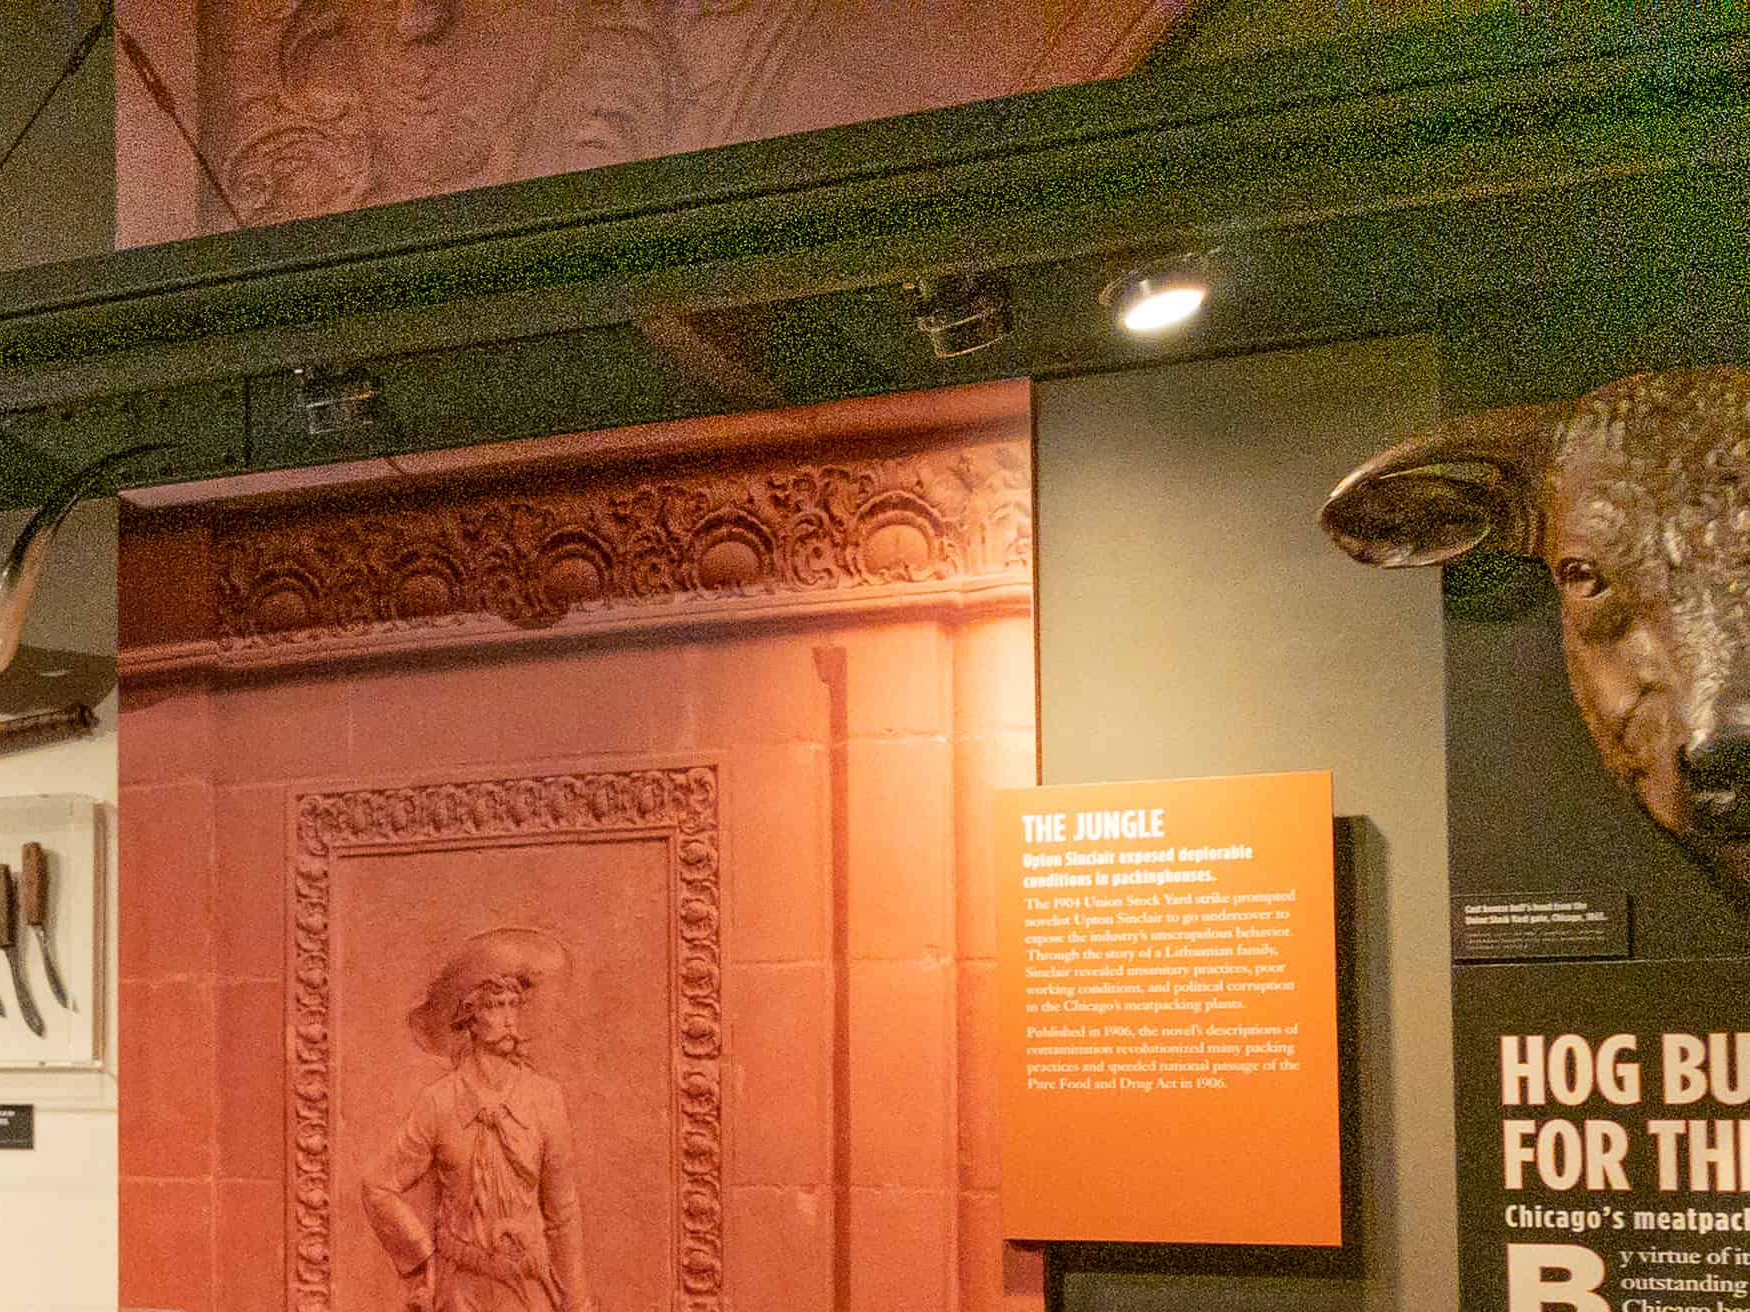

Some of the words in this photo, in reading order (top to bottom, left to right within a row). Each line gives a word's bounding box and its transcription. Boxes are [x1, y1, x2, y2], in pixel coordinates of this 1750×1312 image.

[1022, 814, 1067, 844] THE
[1072, 808, 1165, 842] JUNGLE
[1500, 1033, 1642, 1106] HOG
[1662, 1031, 1750, 1106] BU
[1503, 1119, 1632, 1192] FOR
[1505, 1205, 1626, 1233] Chicago's
[1621, 1251, 1634, 1269] y
[1638, 1246, 1702, 1264] virtue
[1706, 1247, 1730, 1265] of
[1621, 1273, 1748, 1298] outstanding
